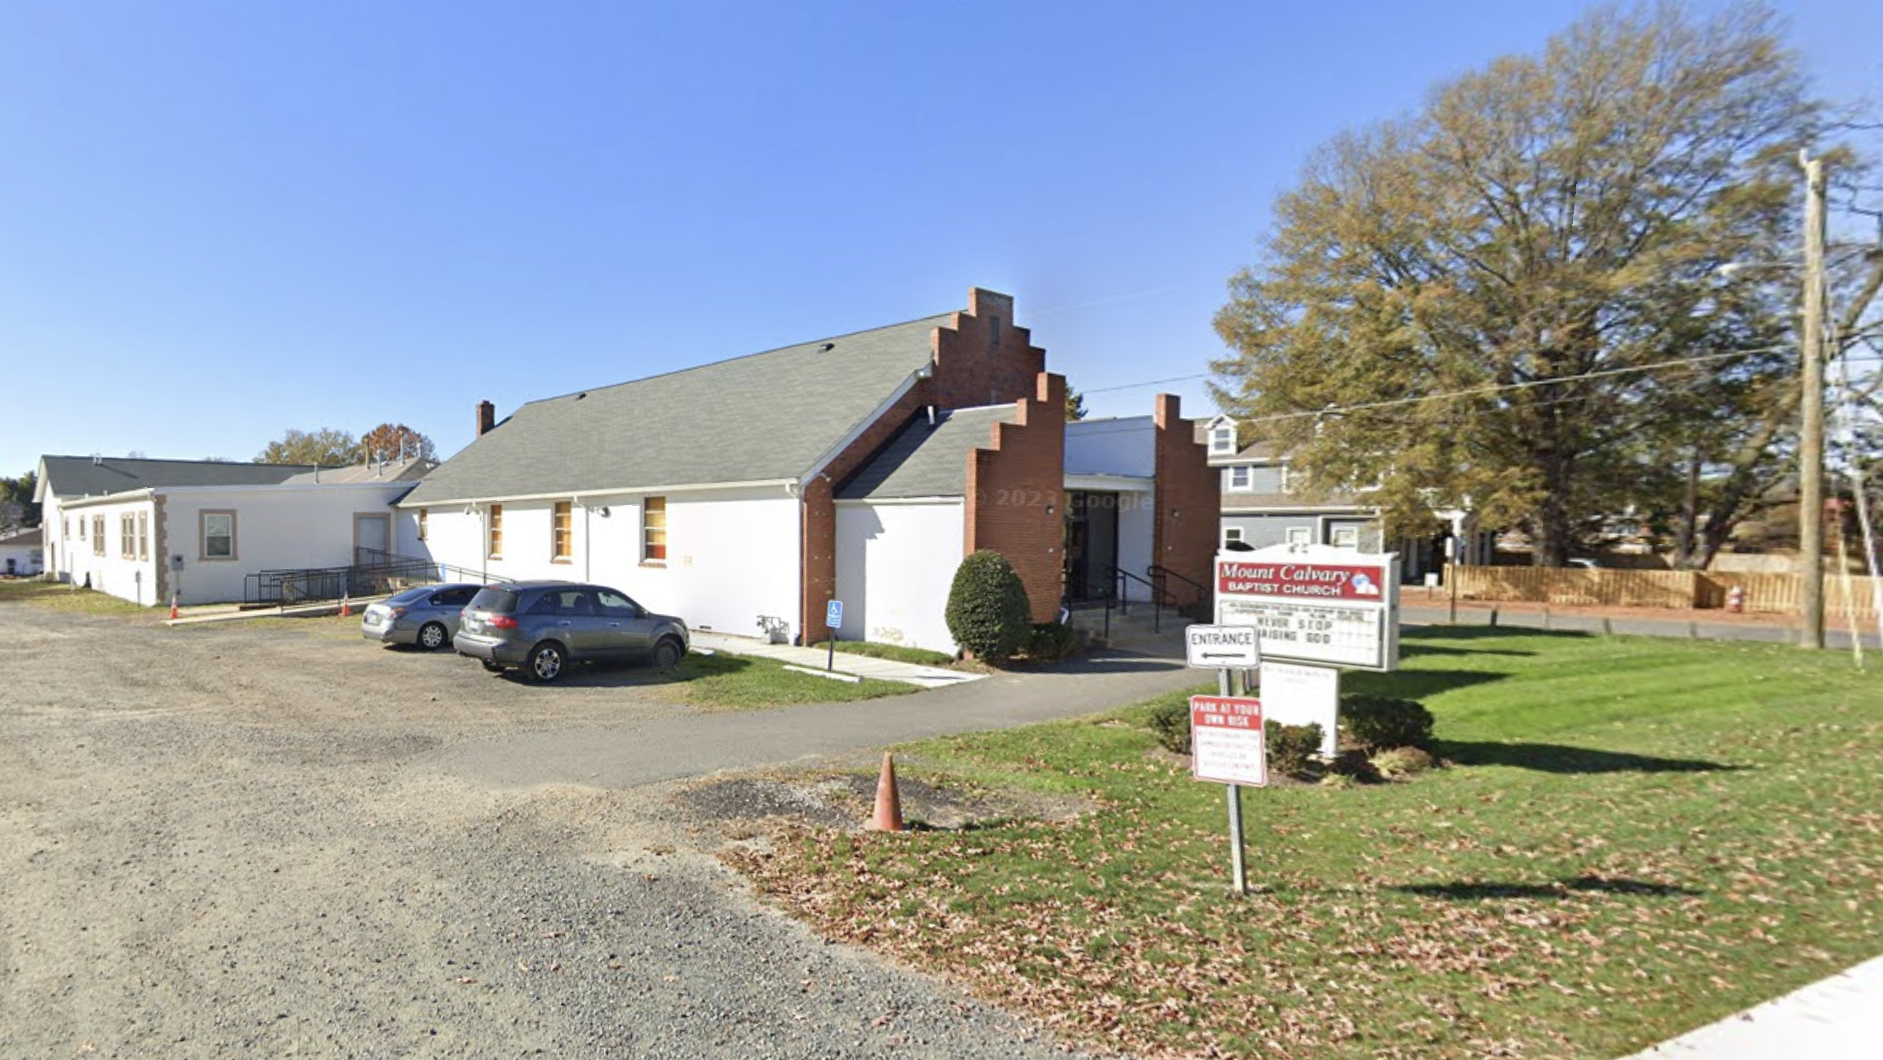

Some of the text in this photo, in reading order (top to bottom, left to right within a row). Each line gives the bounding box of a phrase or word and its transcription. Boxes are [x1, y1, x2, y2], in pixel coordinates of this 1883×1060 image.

[1221, 564, 1350, 586] Mount Calvary
[1228, 581, 1342, 596] BAPTIST CHURCH
[1298, 619, 1333, 631] STOP
[1191, 632, 1253, 646] ENTRANCE
[1306, 632, 1331, 644] GOD
[1193, 701, 1260, 716] PARK AT YOUR
[1204, 713, 1250, 727] OWN RISK
